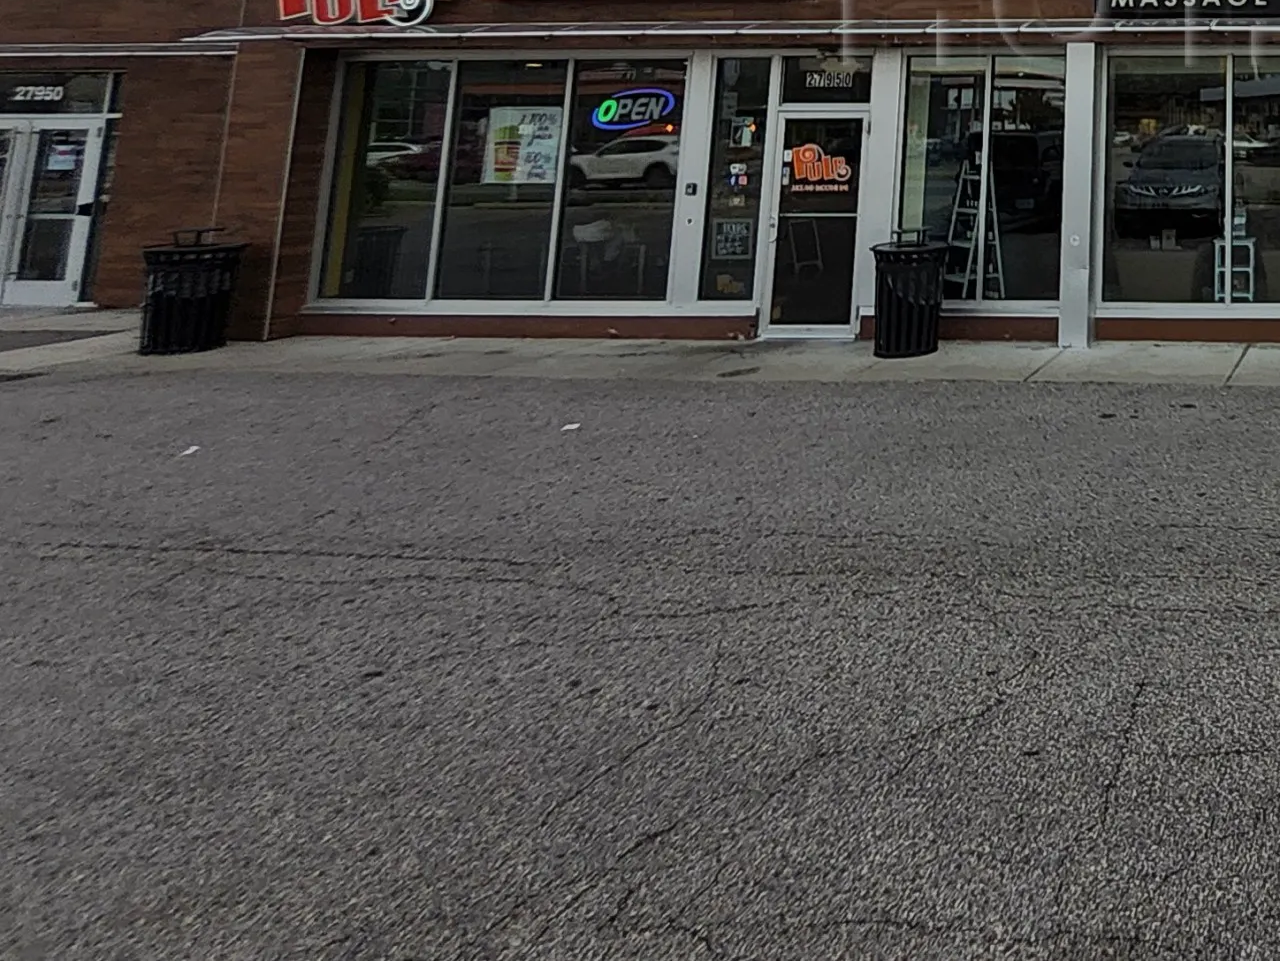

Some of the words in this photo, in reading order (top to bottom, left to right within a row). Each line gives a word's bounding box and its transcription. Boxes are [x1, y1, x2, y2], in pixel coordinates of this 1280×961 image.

[806, 72, 853, 87] 27950
[14, 86, 64, 100] 27950
[598, 98, 666, 122] OPEN
